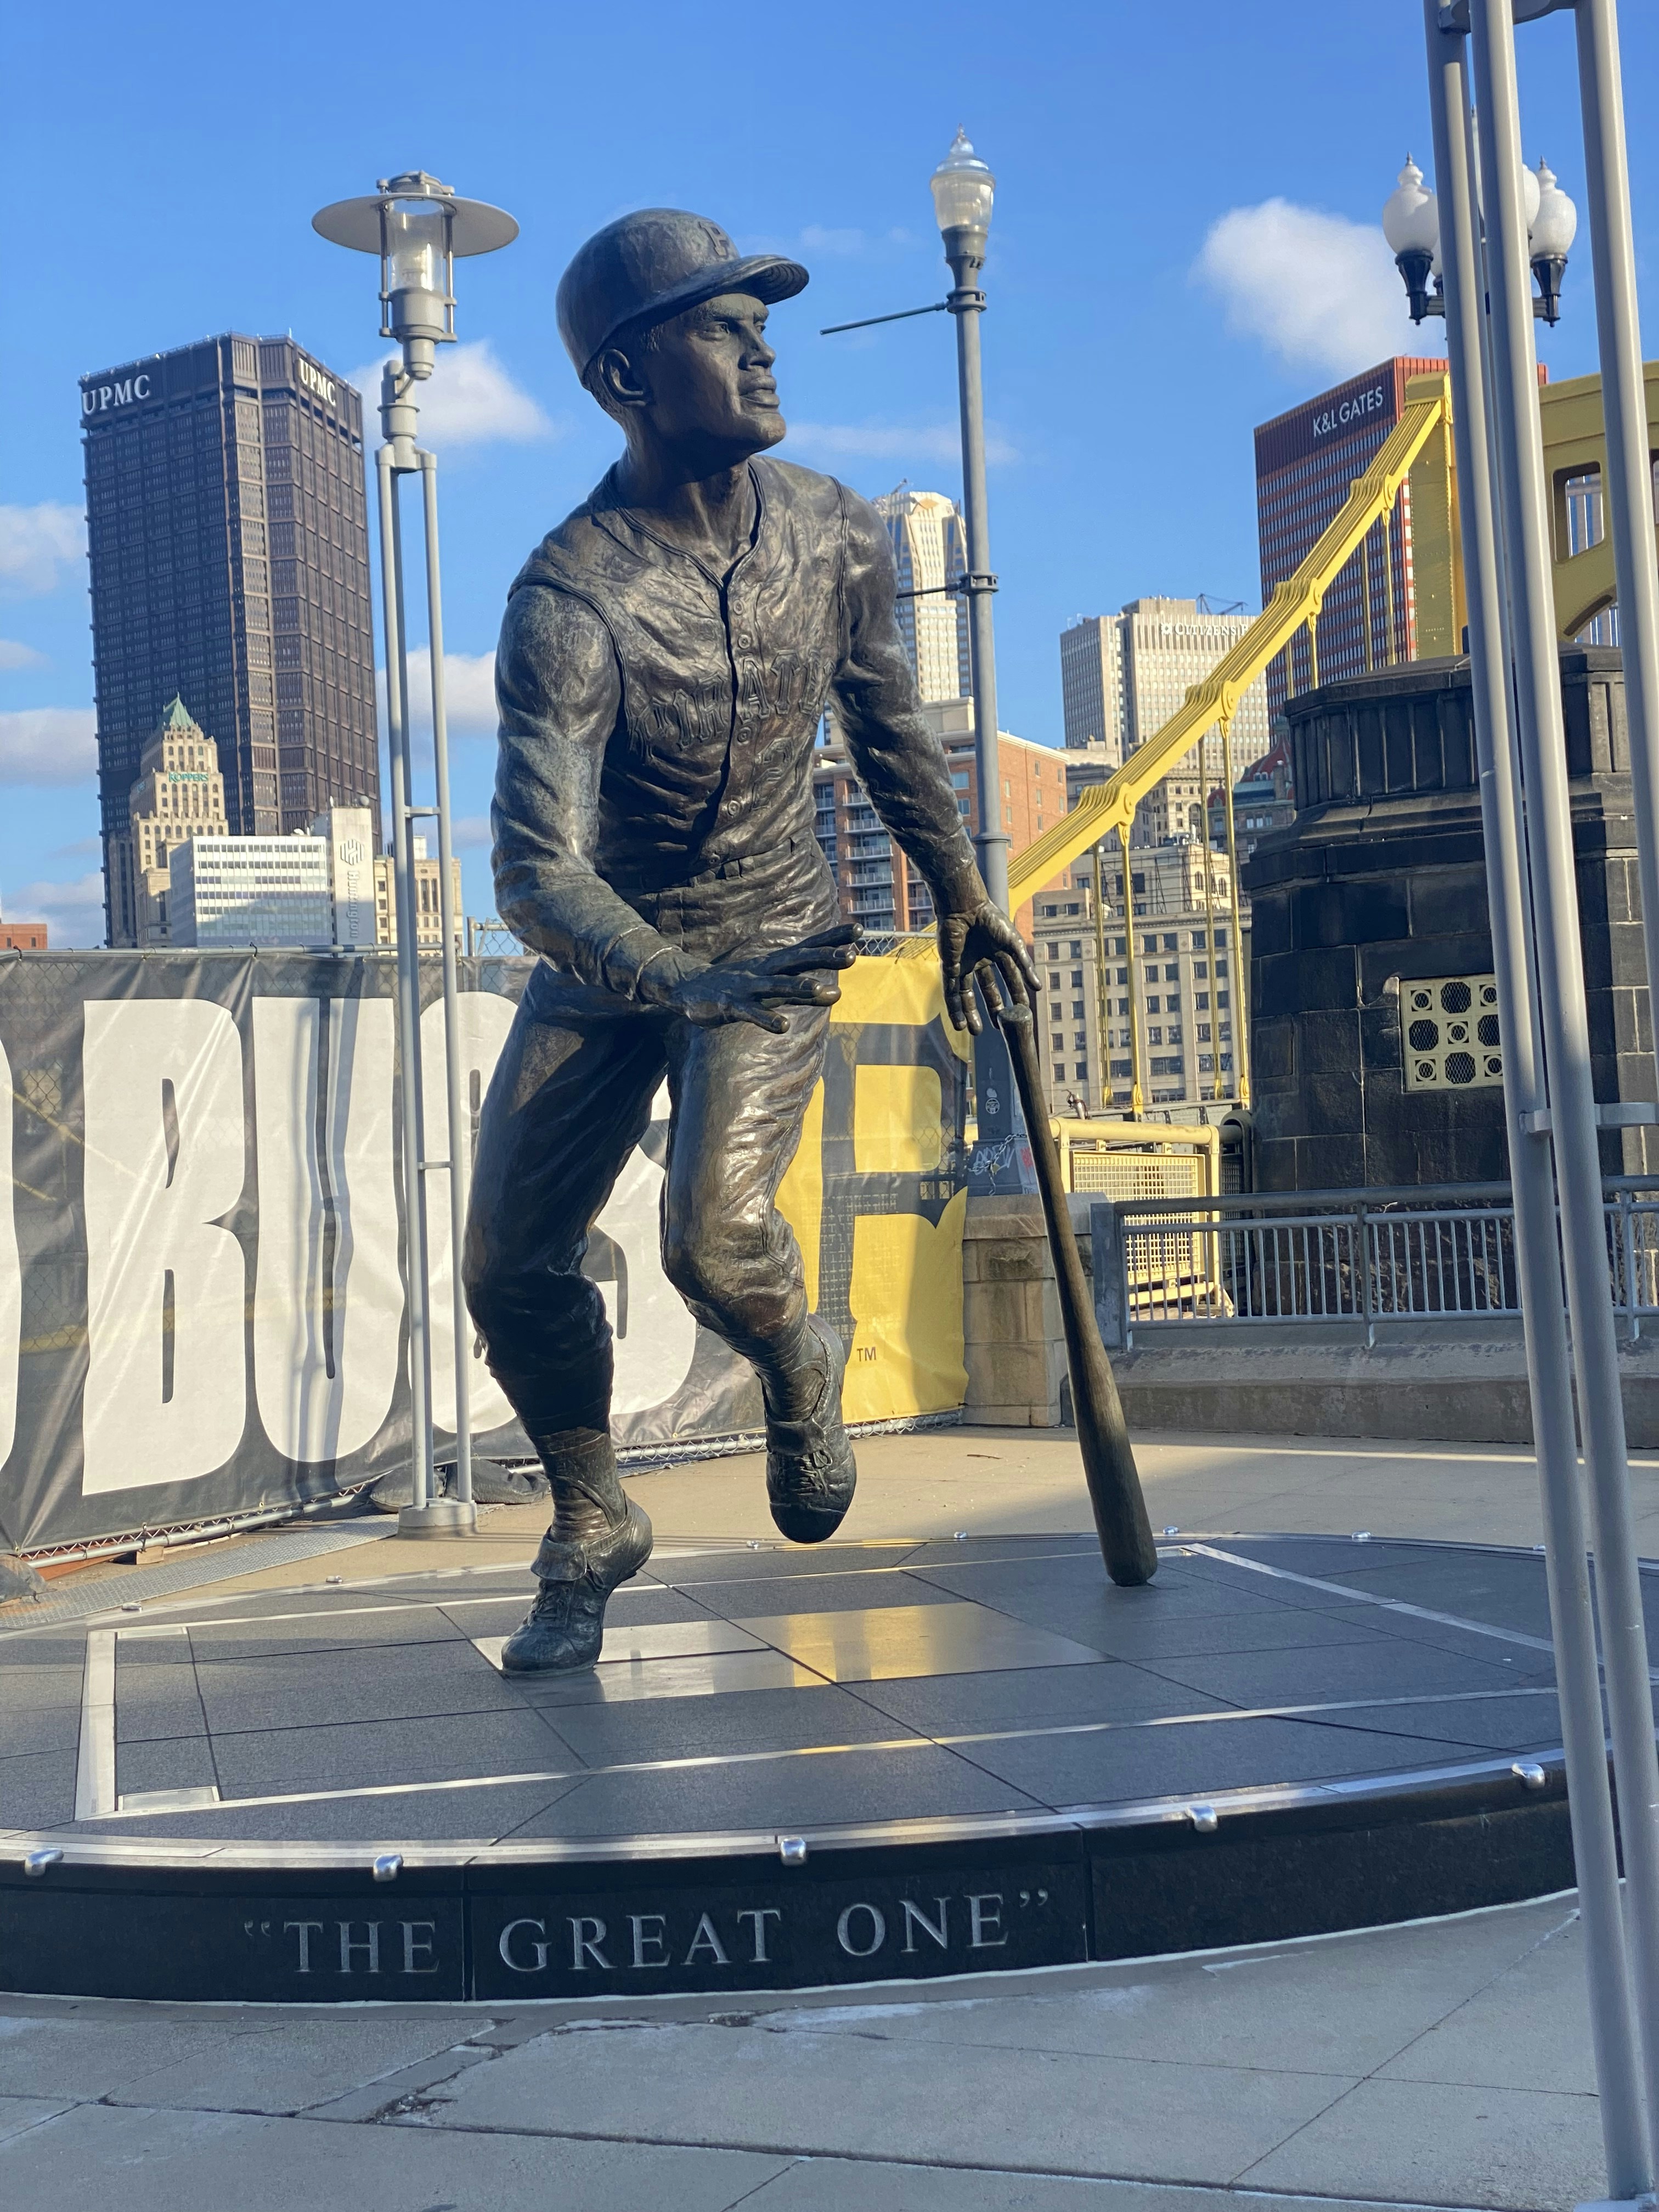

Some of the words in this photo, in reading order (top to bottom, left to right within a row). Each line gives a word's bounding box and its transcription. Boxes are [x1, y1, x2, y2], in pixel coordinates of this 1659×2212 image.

[82, 374, 150, 415] UPMC
[298, 358, 336, 406] UPMC
[1314, 409, 1338, 438] K&L
[1339, 386, 1383, 423] GATES
[347, 870, 359, 938] Huntington
[856, 1346, 877, 1362] TM
[244, 1920, 439, 1973] “THE
[499, 1908, 781, 1972] GREAT
[837, 1888, 1049, 1956] ONE”
